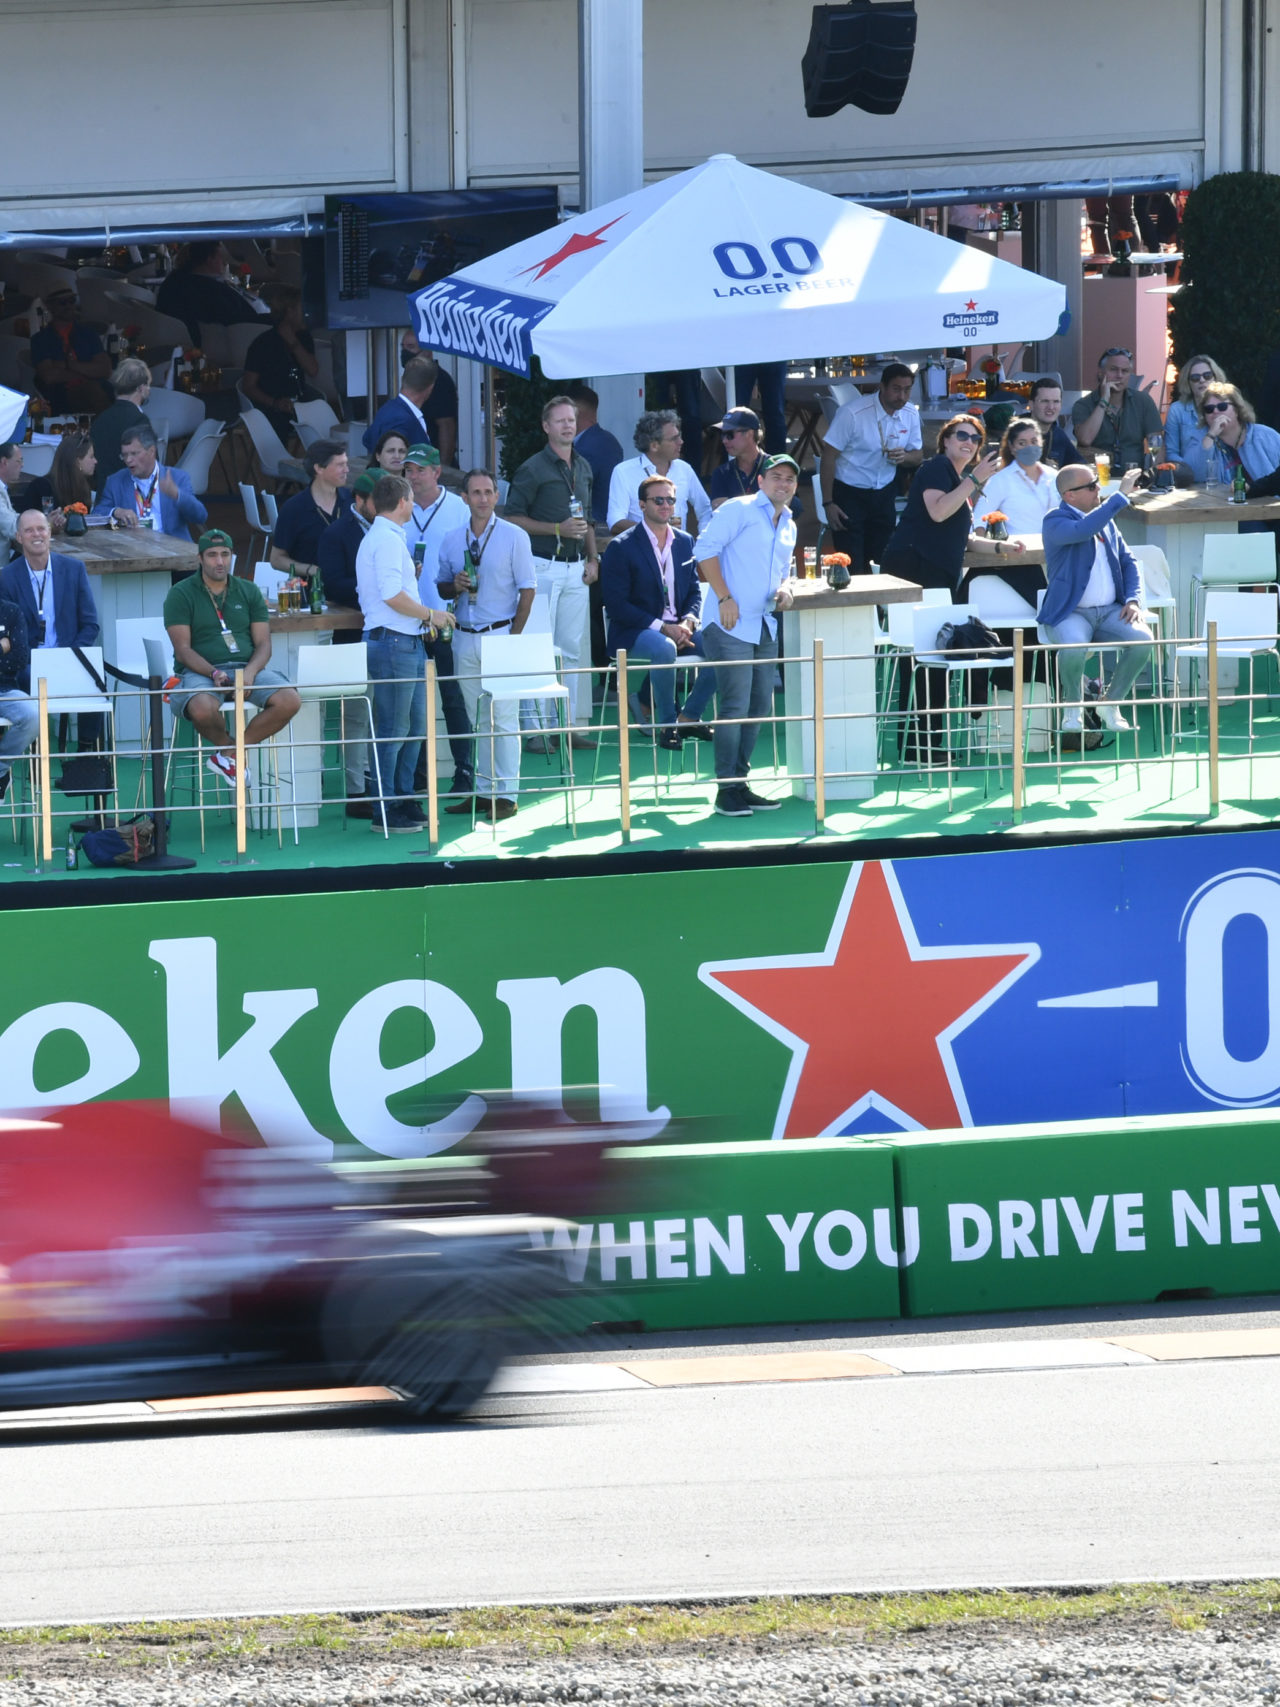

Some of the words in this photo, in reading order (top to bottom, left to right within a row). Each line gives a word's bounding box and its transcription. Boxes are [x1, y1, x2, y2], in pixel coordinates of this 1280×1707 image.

[713, 237, 824, 280] 0.0
[713, 283, 791, 298] LAGER
[795, 278, 855, 291] BEER
[415, 282, 528, 371] Heineken
[946, 315, 995, 325] Heineken
[766, 1206, 920, 1271] YOU
[948, 1193, 1146, 1262] DRIVE
